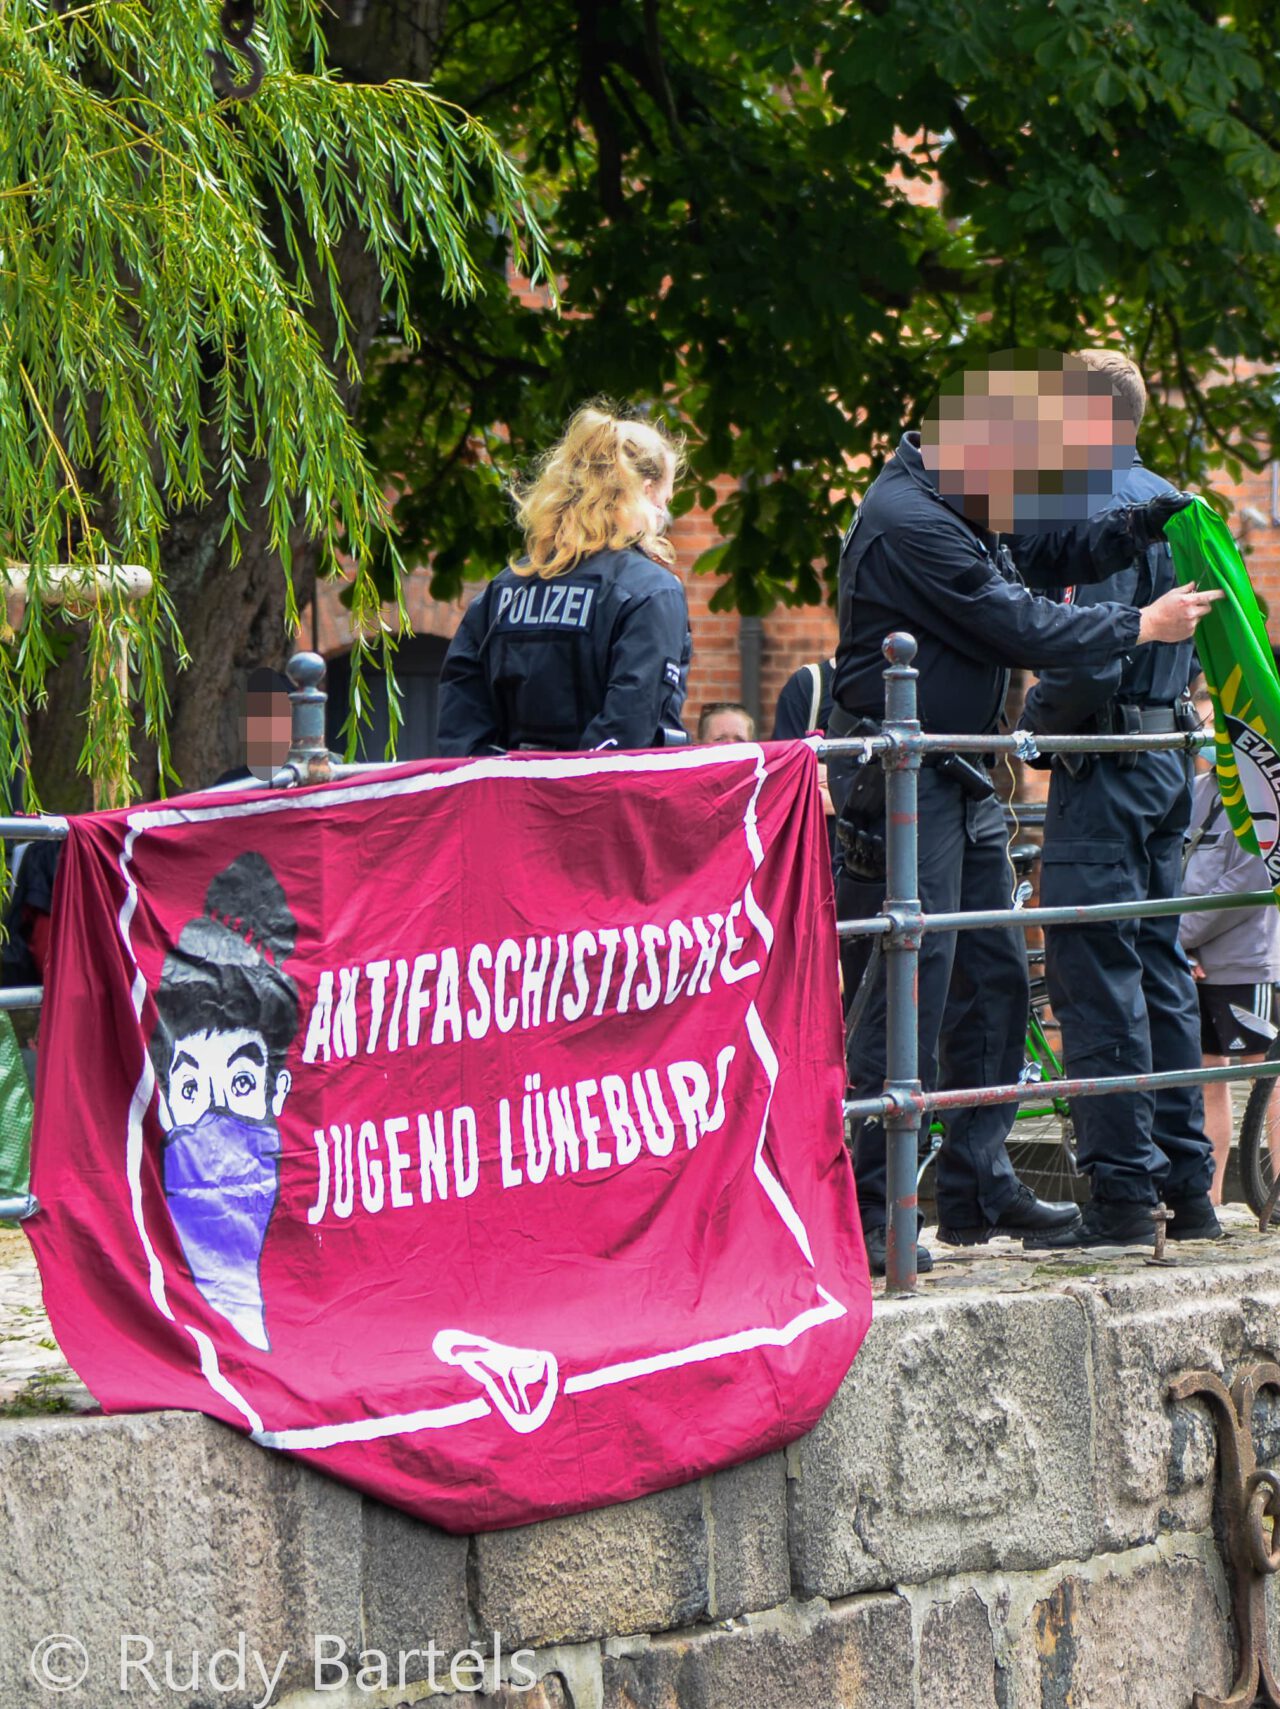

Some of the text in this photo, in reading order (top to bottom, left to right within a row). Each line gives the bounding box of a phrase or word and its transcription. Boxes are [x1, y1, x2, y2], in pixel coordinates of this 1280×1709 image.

[498, 586, 594, 627] POLIZEI
[303, 900, 761, 1064] ANTIFASCHISTISCHE
[307, 1106, 479, 1225] JUGEND
